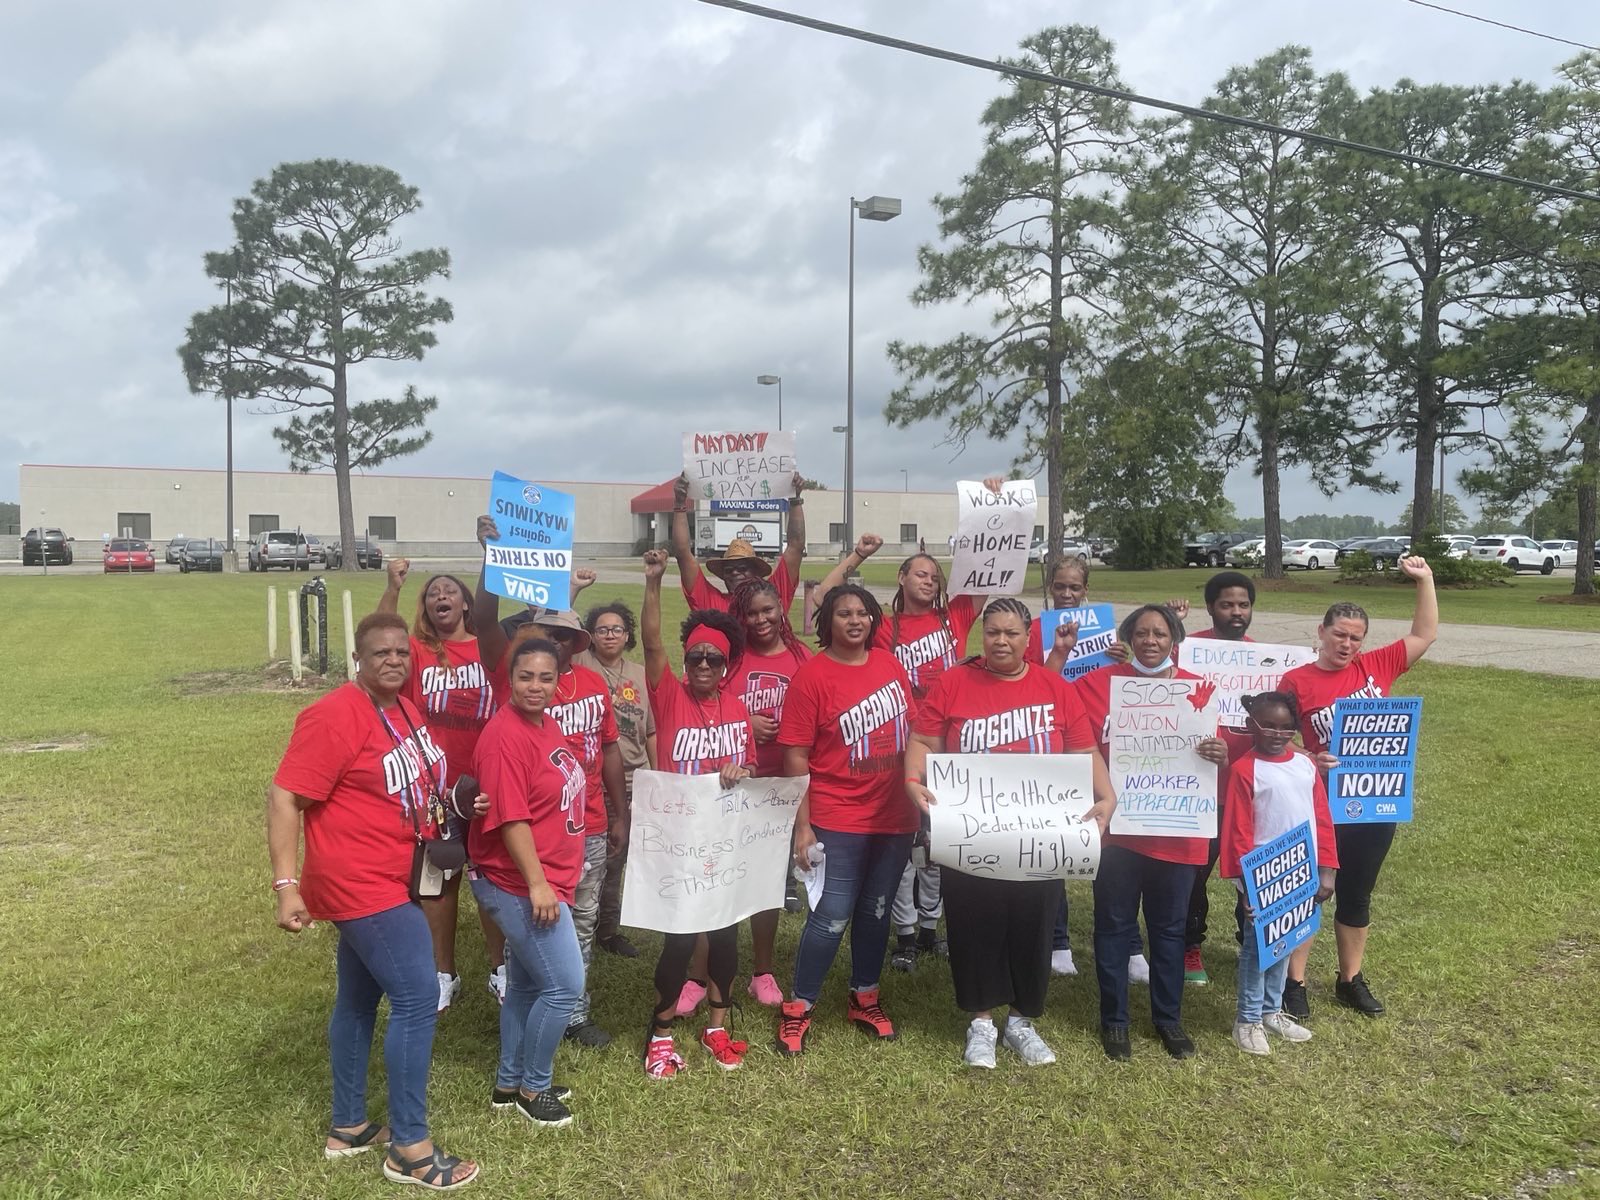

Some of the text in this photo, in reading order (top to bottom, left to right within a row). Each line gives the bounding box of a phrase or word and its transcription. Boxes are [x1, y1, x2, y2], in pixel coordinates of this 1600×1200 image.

[696, 456, 791, 479] INCREASE
[718, 481, 756, 498] PAY
[967, 490, 1022, 508] WORK
[496, 498, 569, 532] MAXIMUS
[719, 501, 755, 509] MAXIMUS
[510, 525, 551, 544] against
[973, 532, 1026, 553] HOME
[490, 548, 566, 568] ON STRIKE
[984, 557, 995, 569] 4
[964, 570, 1015, 588] ALL!!
[504, 577, 549, 605] CWA
[1060, 609, 1099, 626] CWA
[894, 620, 958, 670] ORGANI
[1071, 633, 1113, 658] STRIKE
[1193, 648, 1297, 668] EDUCATE to
[422, 662, 490, 696] ORGANI
[1122, 680, 1191, 705] STOP
[1339, 702, 1361, 710] WHAT
[1364, 702, 1374, 710] DO
[1377, 702, 1389, 710] WE
[960, 703, 1055, 754] ORGANIZE
[1118, 714, 1180, 732] UNION
[1344, 715, 1409, 733] HIGHER
[672, 721, 748, 762] ORGANIZE
[1342, 737, 1408, 755] WAGES!
[1117, 754, 1178, 772] START
[933, 760, 970, 806] My
[1126, 774, 1199, 790] WORKER
[1342, 774, 1404, 797] NOW!
[715, 791, 750, 817] Talk
[754, 788, 800, 808] About
[1117, 792, 1215, 814] APPRECIATION
[1376, 804, 1397, 813] CWA
[960, 812, 1082, 839] Deductible is
[636, 818, 791, 858] Business Conduct
[1244, 826, 1308, 868] WHAT DO WE WANT?
[1255, 842, 1306, 887] HIGHER
[1259, 862, 1310, 908] WAGES!
[1256, 882, 1318, 924] WHEN DO WE WANT IT?
[1268, 896, 1314, 944] NOW!
[1296, 924, 1311, 939] CWA
